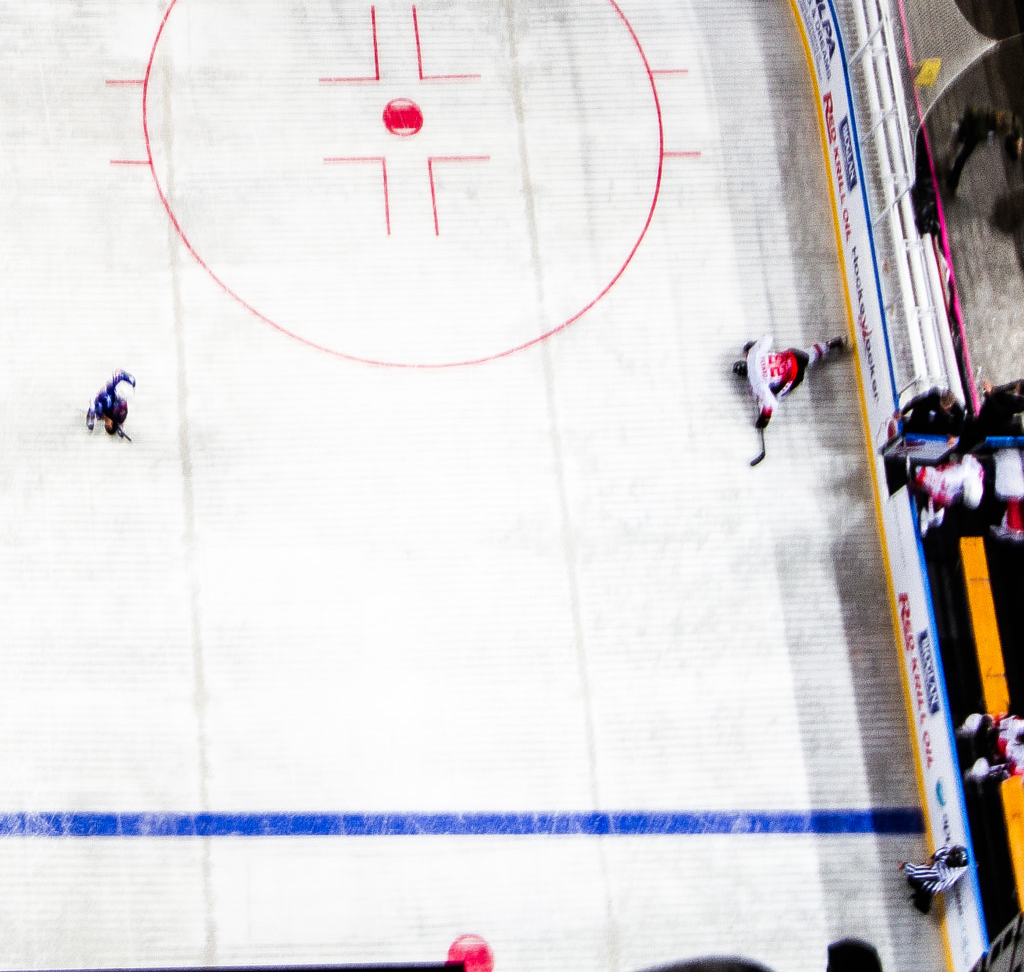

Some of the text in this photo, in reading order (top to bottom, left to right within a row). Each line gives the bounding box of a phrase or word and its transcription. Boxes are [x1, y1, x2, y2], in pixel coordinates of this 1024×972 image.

[823, 91, 851, 242] RED KRILL OIL
